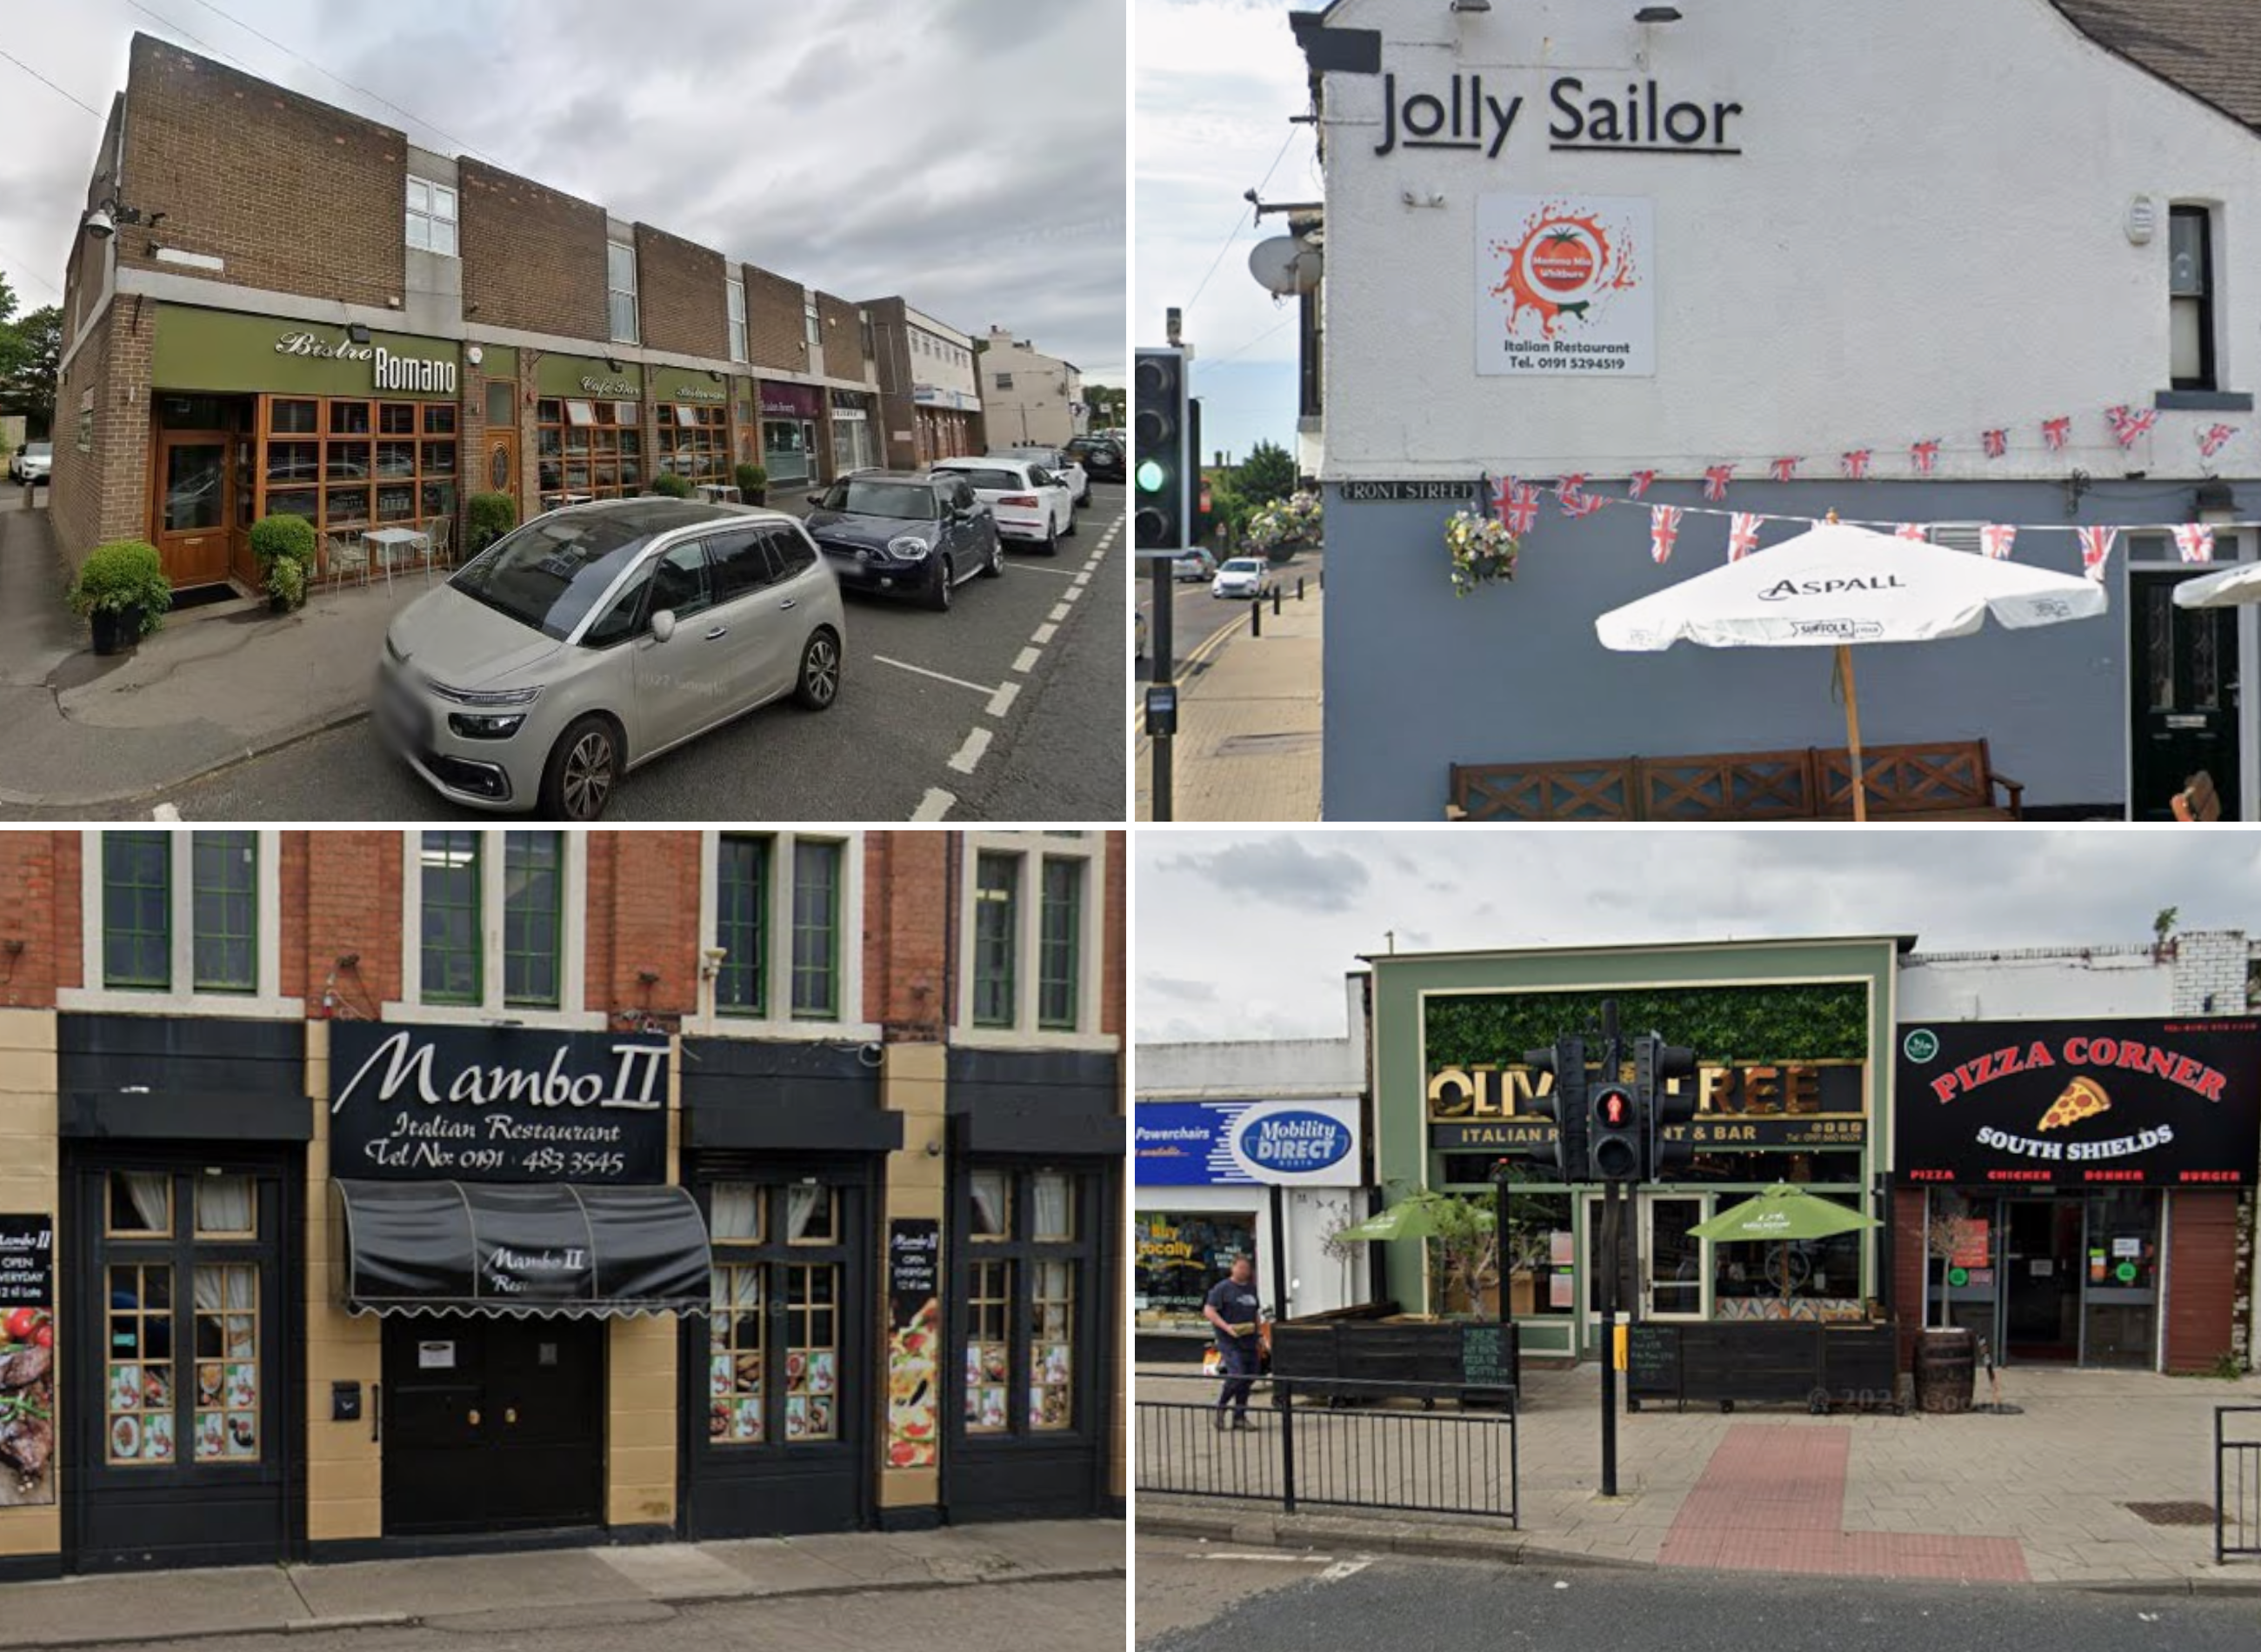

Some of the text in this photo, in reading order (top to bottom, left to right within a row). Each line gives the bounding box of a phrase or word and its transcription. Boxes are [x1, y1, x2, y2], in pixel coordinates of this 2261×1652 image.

[1374, 73, 1743, 159] Jolly Sailor
[1504, 340, 1631, 354] Italian Restaurant
[275, 331, 457, 393] Bistro Romano
[1510, 356, 1625, 370] Tel. 0191 5294519
[1344, 483, 1470, 499] FRONT STREET
[1757, 574, 1906, 601] ASPALL
[1800, 623, 1849, 635] SUFFOLK
[331, 1030, 670, 1114] Mambo II
[1930, 1037, 2228, 1104] PIZZA CORNER
[390, 1111, 622, 1142] Italian Restaurant
[1135, 1125, 1211, 1141] Powerchairs
[1261, 1121, 1337, 1141] Mobility
[1461, 1128, 1538, 1143] ITALIAN
[1693, 1125, 1707, 1141] &
[1713, 1126, 1757, 1141] BAR
[1257, 1139, 1335, 1160] DIRECT
[1976, 1124, 2174, 1161] SOUTH SHIELDS
[364, 1138, 409, 1167] Tel
[459, 1148, 504, 1174] 0191
[522, 1147, 564, 1175] 483
[568, 1151, 625, 1176] 3545
[1911, 1169, 1955, 1181] PIZZA
[1987, 1169, 2051, 1181] CHICKEN
[2180, 1170, 2241, 1182] BURGER
[1151, 1223, 1180, 1241] Buy
[1, 1257, 34, 1269] OPEN
[483, 1246, 584, 1272] Mambo II
